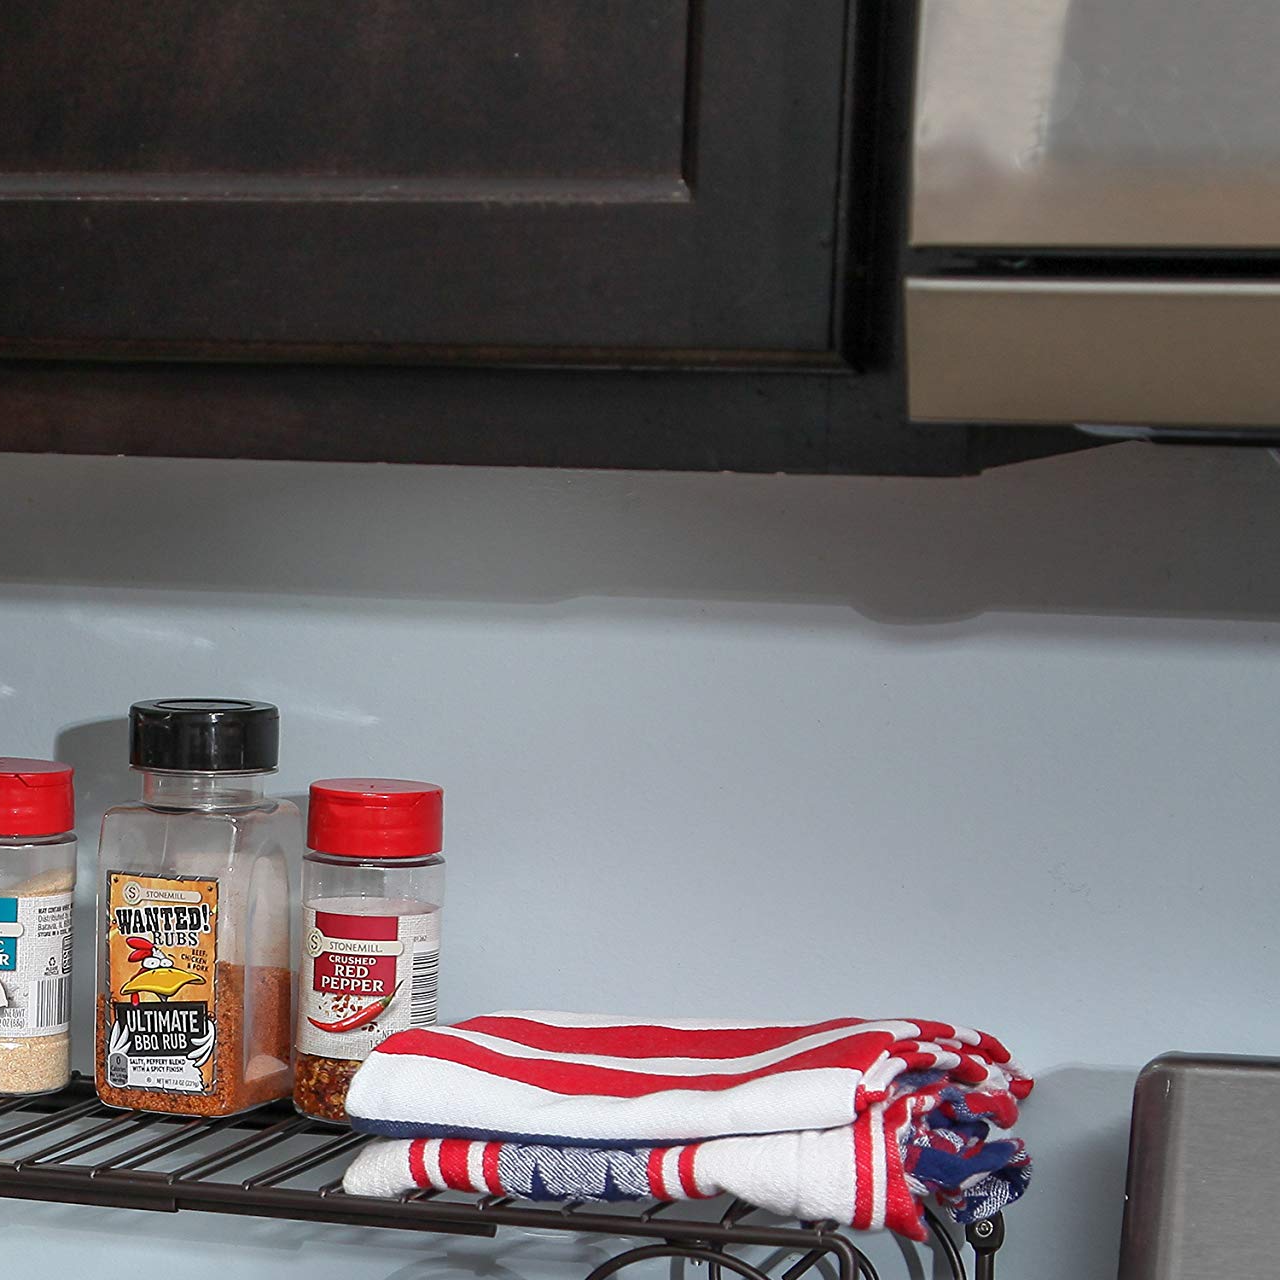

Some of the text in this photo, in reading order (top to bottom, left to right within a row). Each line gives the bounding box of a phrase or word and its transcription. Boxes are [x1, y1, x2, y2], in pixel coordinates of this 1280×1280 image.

[115, 904, 210, 935] WANTED!
[153, 931, 199, 946] RUBS
[181, 953, 207, 964] CHICKEN
[328, 954, 377, 965] CRUSHED
[335, 965, 369, 978] RED
[321, 975, 384, 992] PEPPER
[126, 1009, 200, 1033] ULTIMATE
[134, 1033, 187, 1050] BBQ RUB
